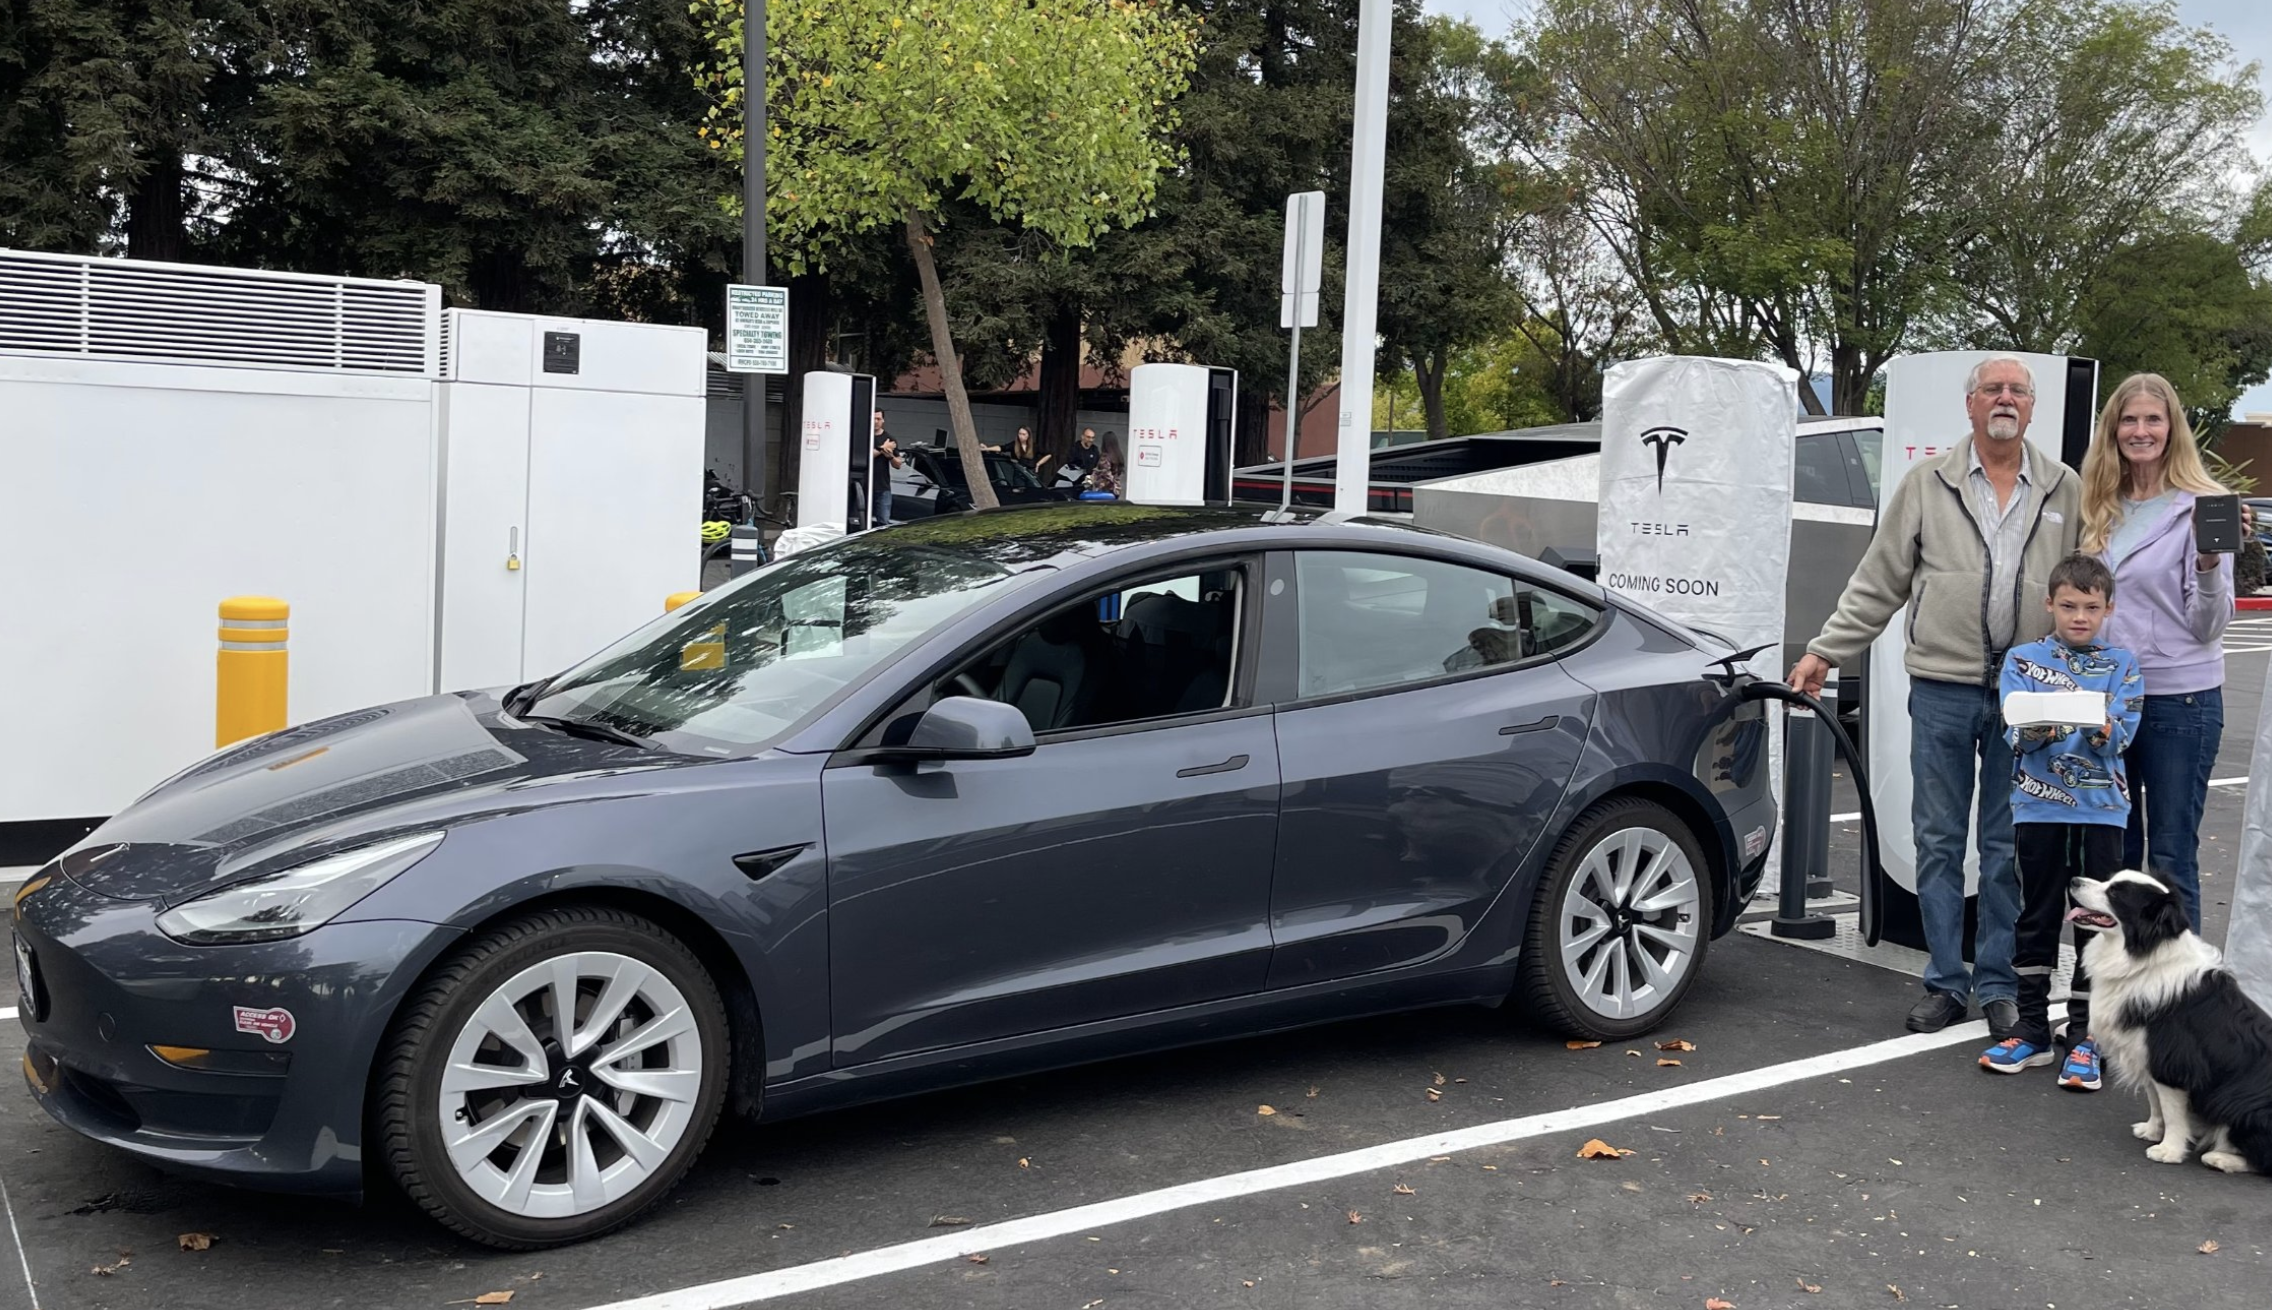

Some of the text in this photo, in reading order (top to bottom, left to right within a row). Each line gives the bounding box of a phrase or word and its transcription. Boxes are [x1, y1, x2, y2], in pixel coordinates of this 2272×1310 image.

[735, 311, 759, 319] TOWED
[732, 329, 782, 340] SPECIALTY TOWING
[803, 421, 831, 430] TESLA
[1133, 429, 1178, 440] TESLA
[1630, 522, 1689, 537] TESLA
[1608, 573, 1719, 597] COMING SOON
[240, 1011, 267, 1020] ACCESS
